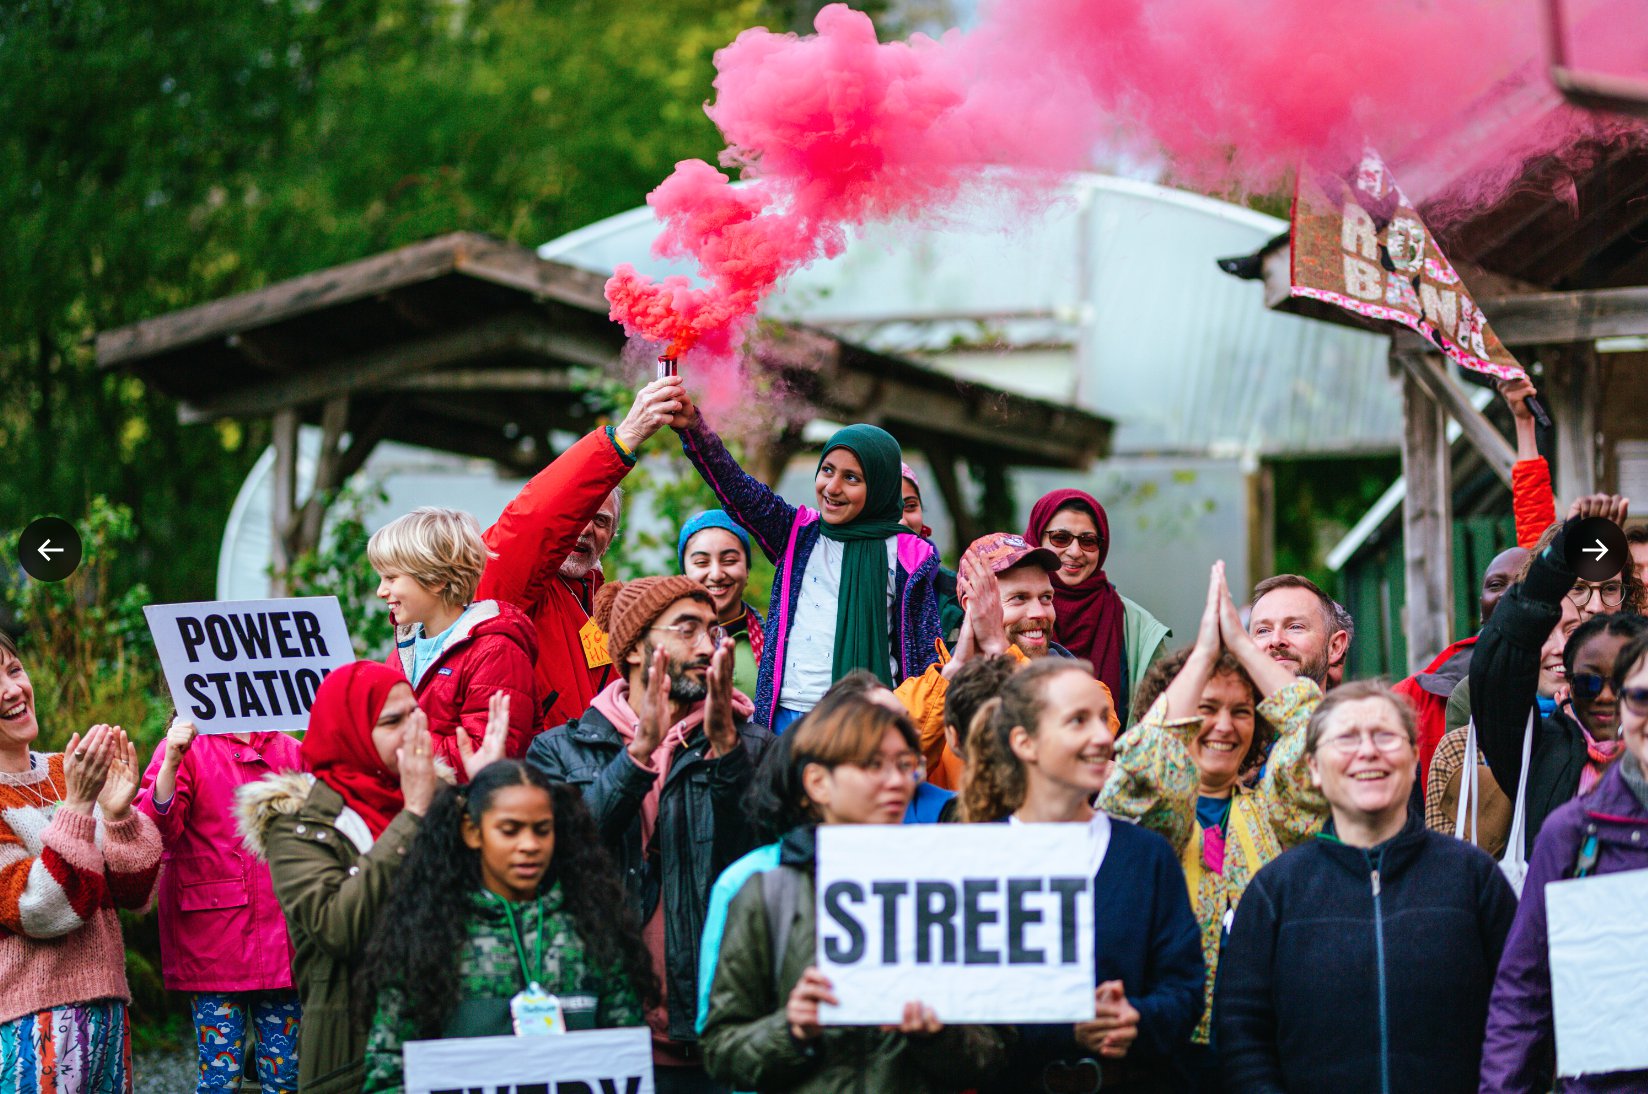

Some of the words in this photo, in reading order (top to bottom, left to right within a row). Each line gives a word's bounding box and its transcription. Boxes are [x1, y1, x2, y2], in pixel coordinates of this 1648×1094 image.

[1343, 253, 1490, 361] BANK
[176, 611, 330, 662] POWER
[184, 668, 331, 720] STATIO
[824, 878, 1087, 964] STREET
